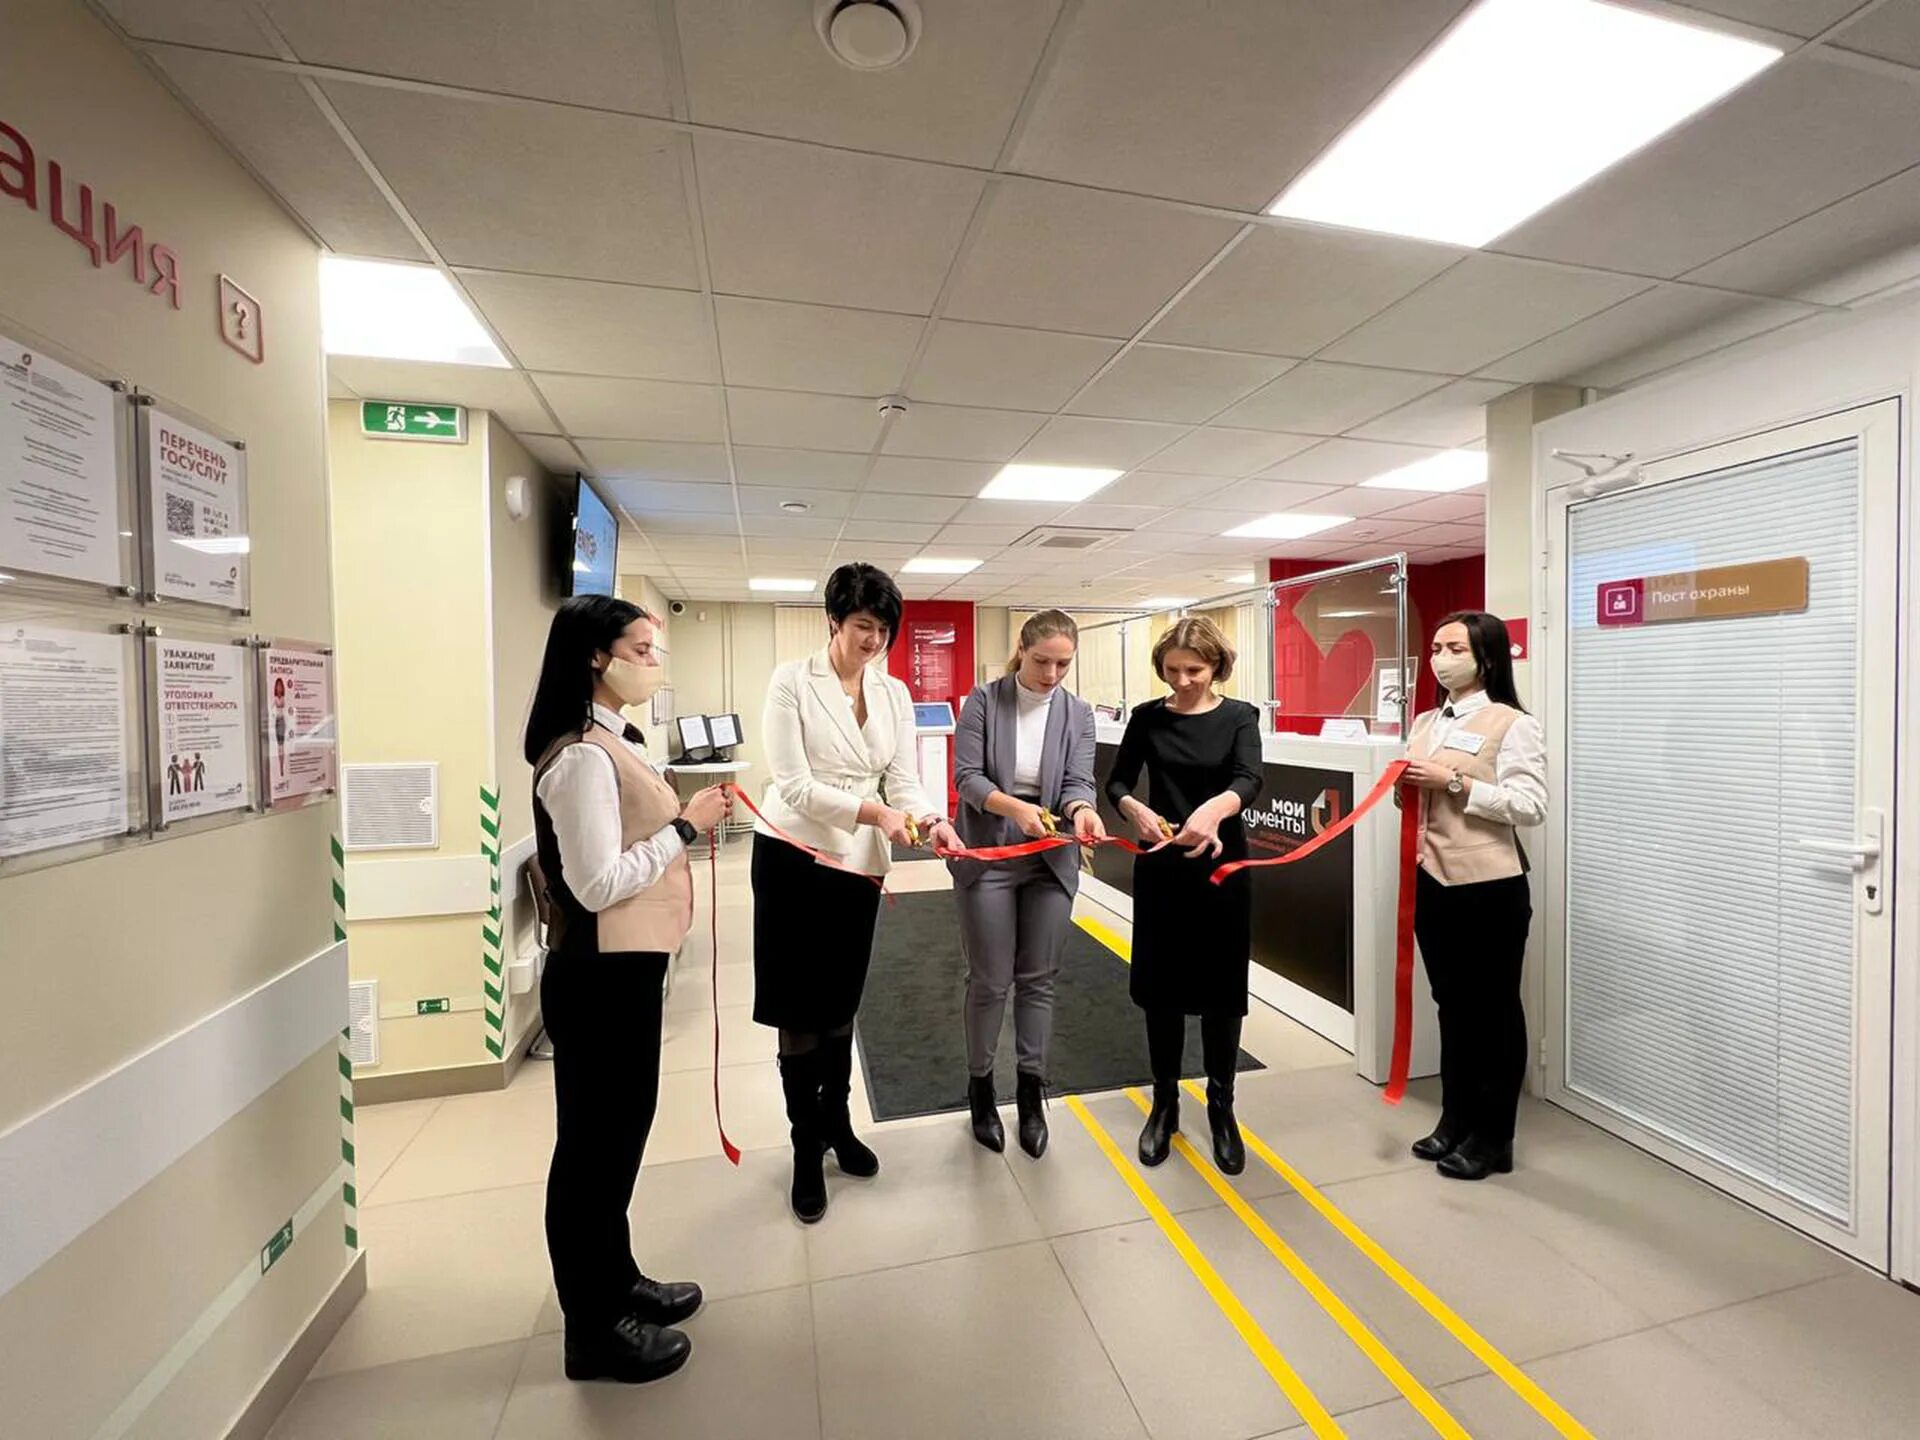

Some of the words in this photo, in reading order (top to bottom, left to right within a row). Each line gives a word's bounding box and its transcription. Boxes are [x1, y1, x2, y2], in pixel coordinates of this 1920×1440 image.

[160, 428, 227, 469] ПЕРЕЧЕНЬ
[160, 446, 228, 485] ГОСУСЛУГ
[1651, 590, 1687, 605] Пост
[1689, 584, 1750, 600] охраны
[914, 643, 920, 652] 1
[163, 647, 216, 661] УВАЖАЕМЫЕ
[914, 654, 920, 664] 2
[914, 666, 920, 676] 3
[914, 678, 921, 688] 4
[163, 690, 214, 699] УГОЛОВНАЯ
[164, 700, 238, 711] ОТВЕТСТВЕННОСТЬ
